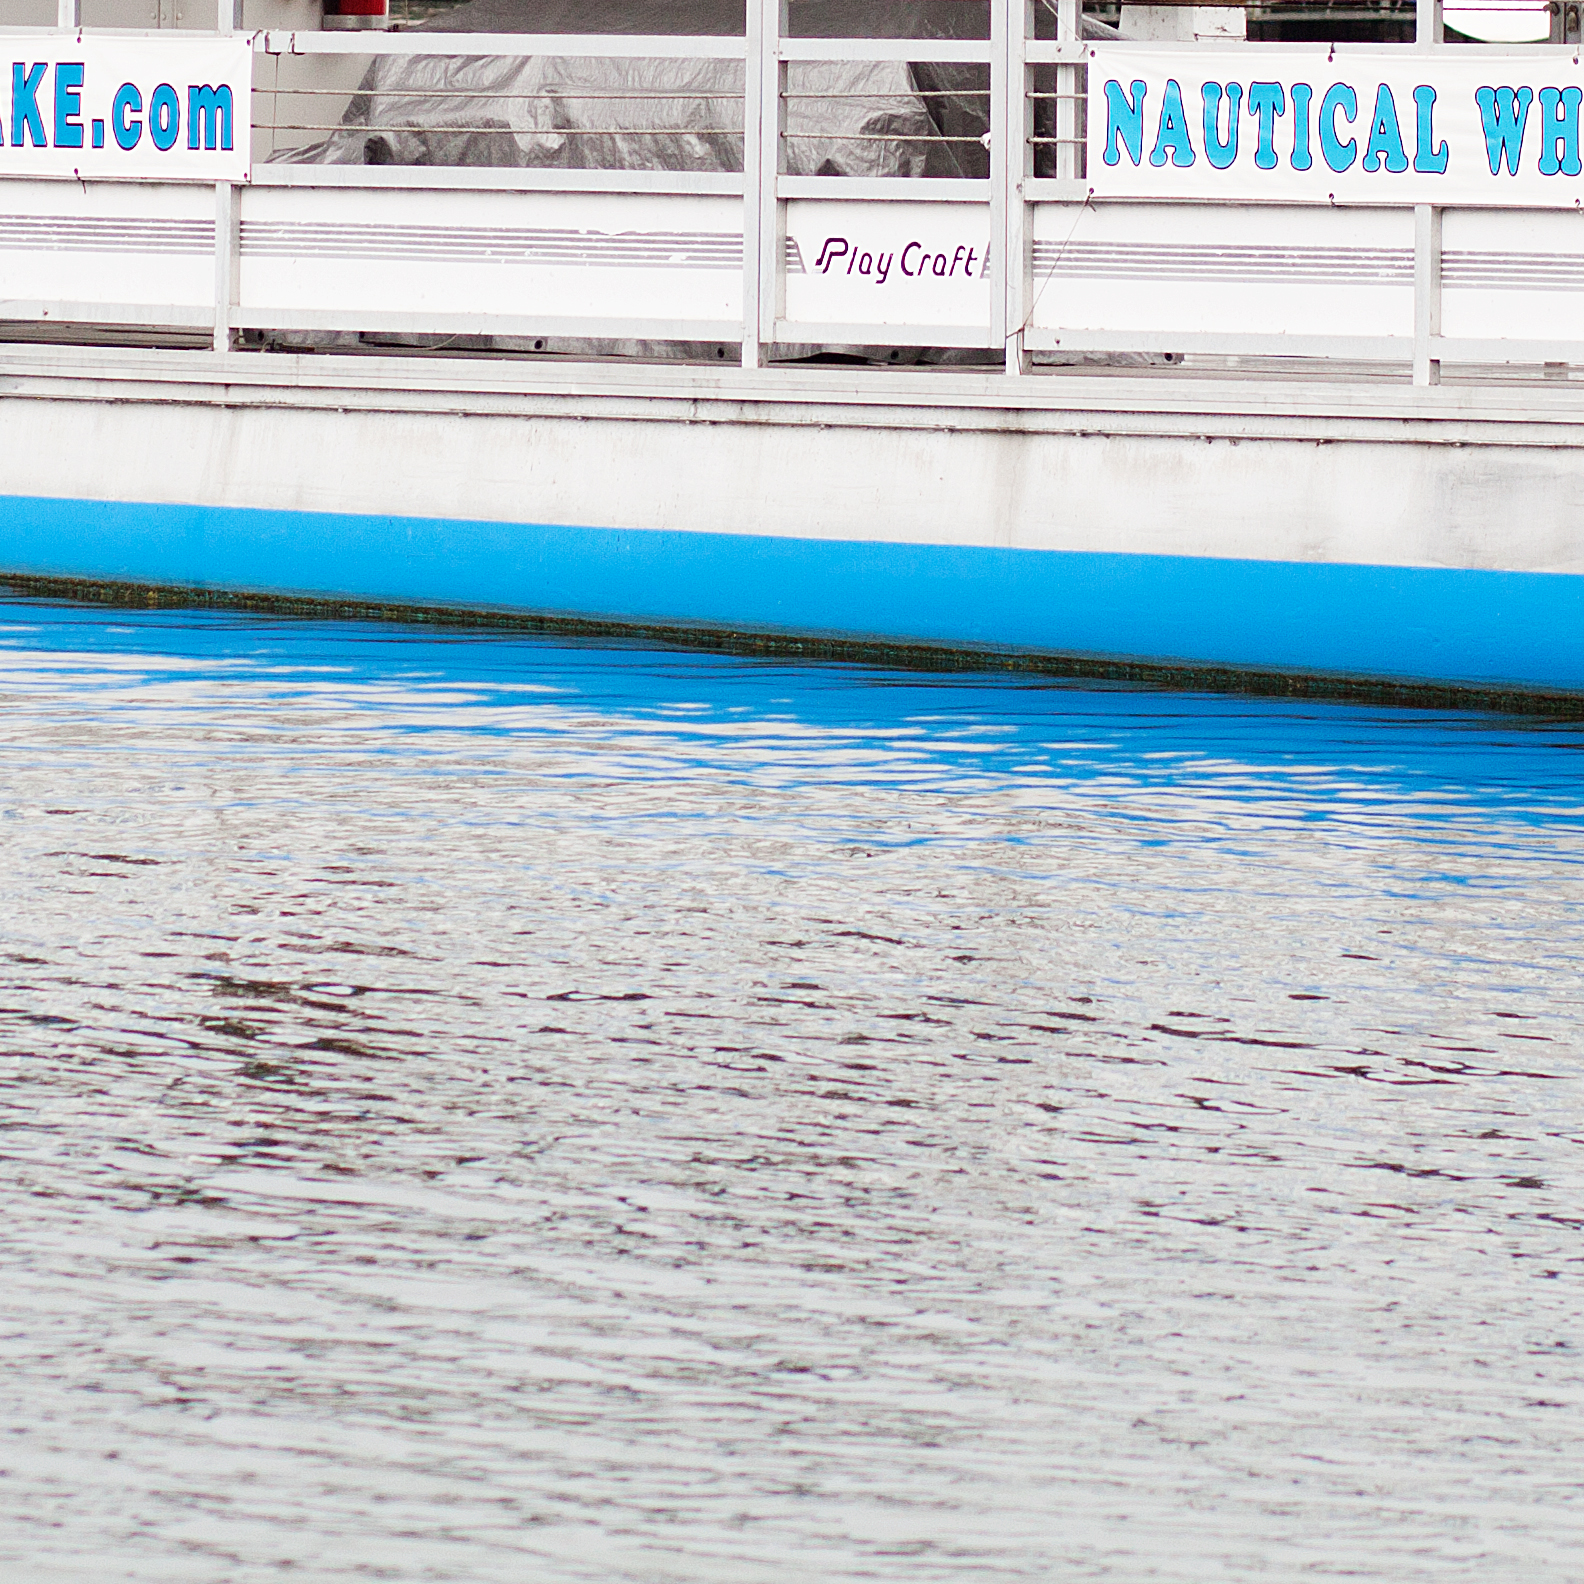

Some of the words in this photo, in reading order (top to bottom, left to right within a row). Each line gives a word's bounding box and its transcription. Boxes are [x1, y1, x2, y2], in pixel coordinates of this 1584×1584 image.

[1103, 79, 1450, 175] NAUTICAL
[816, 237, 894, 285] Play
[900, 241, 978, 277] Craft
